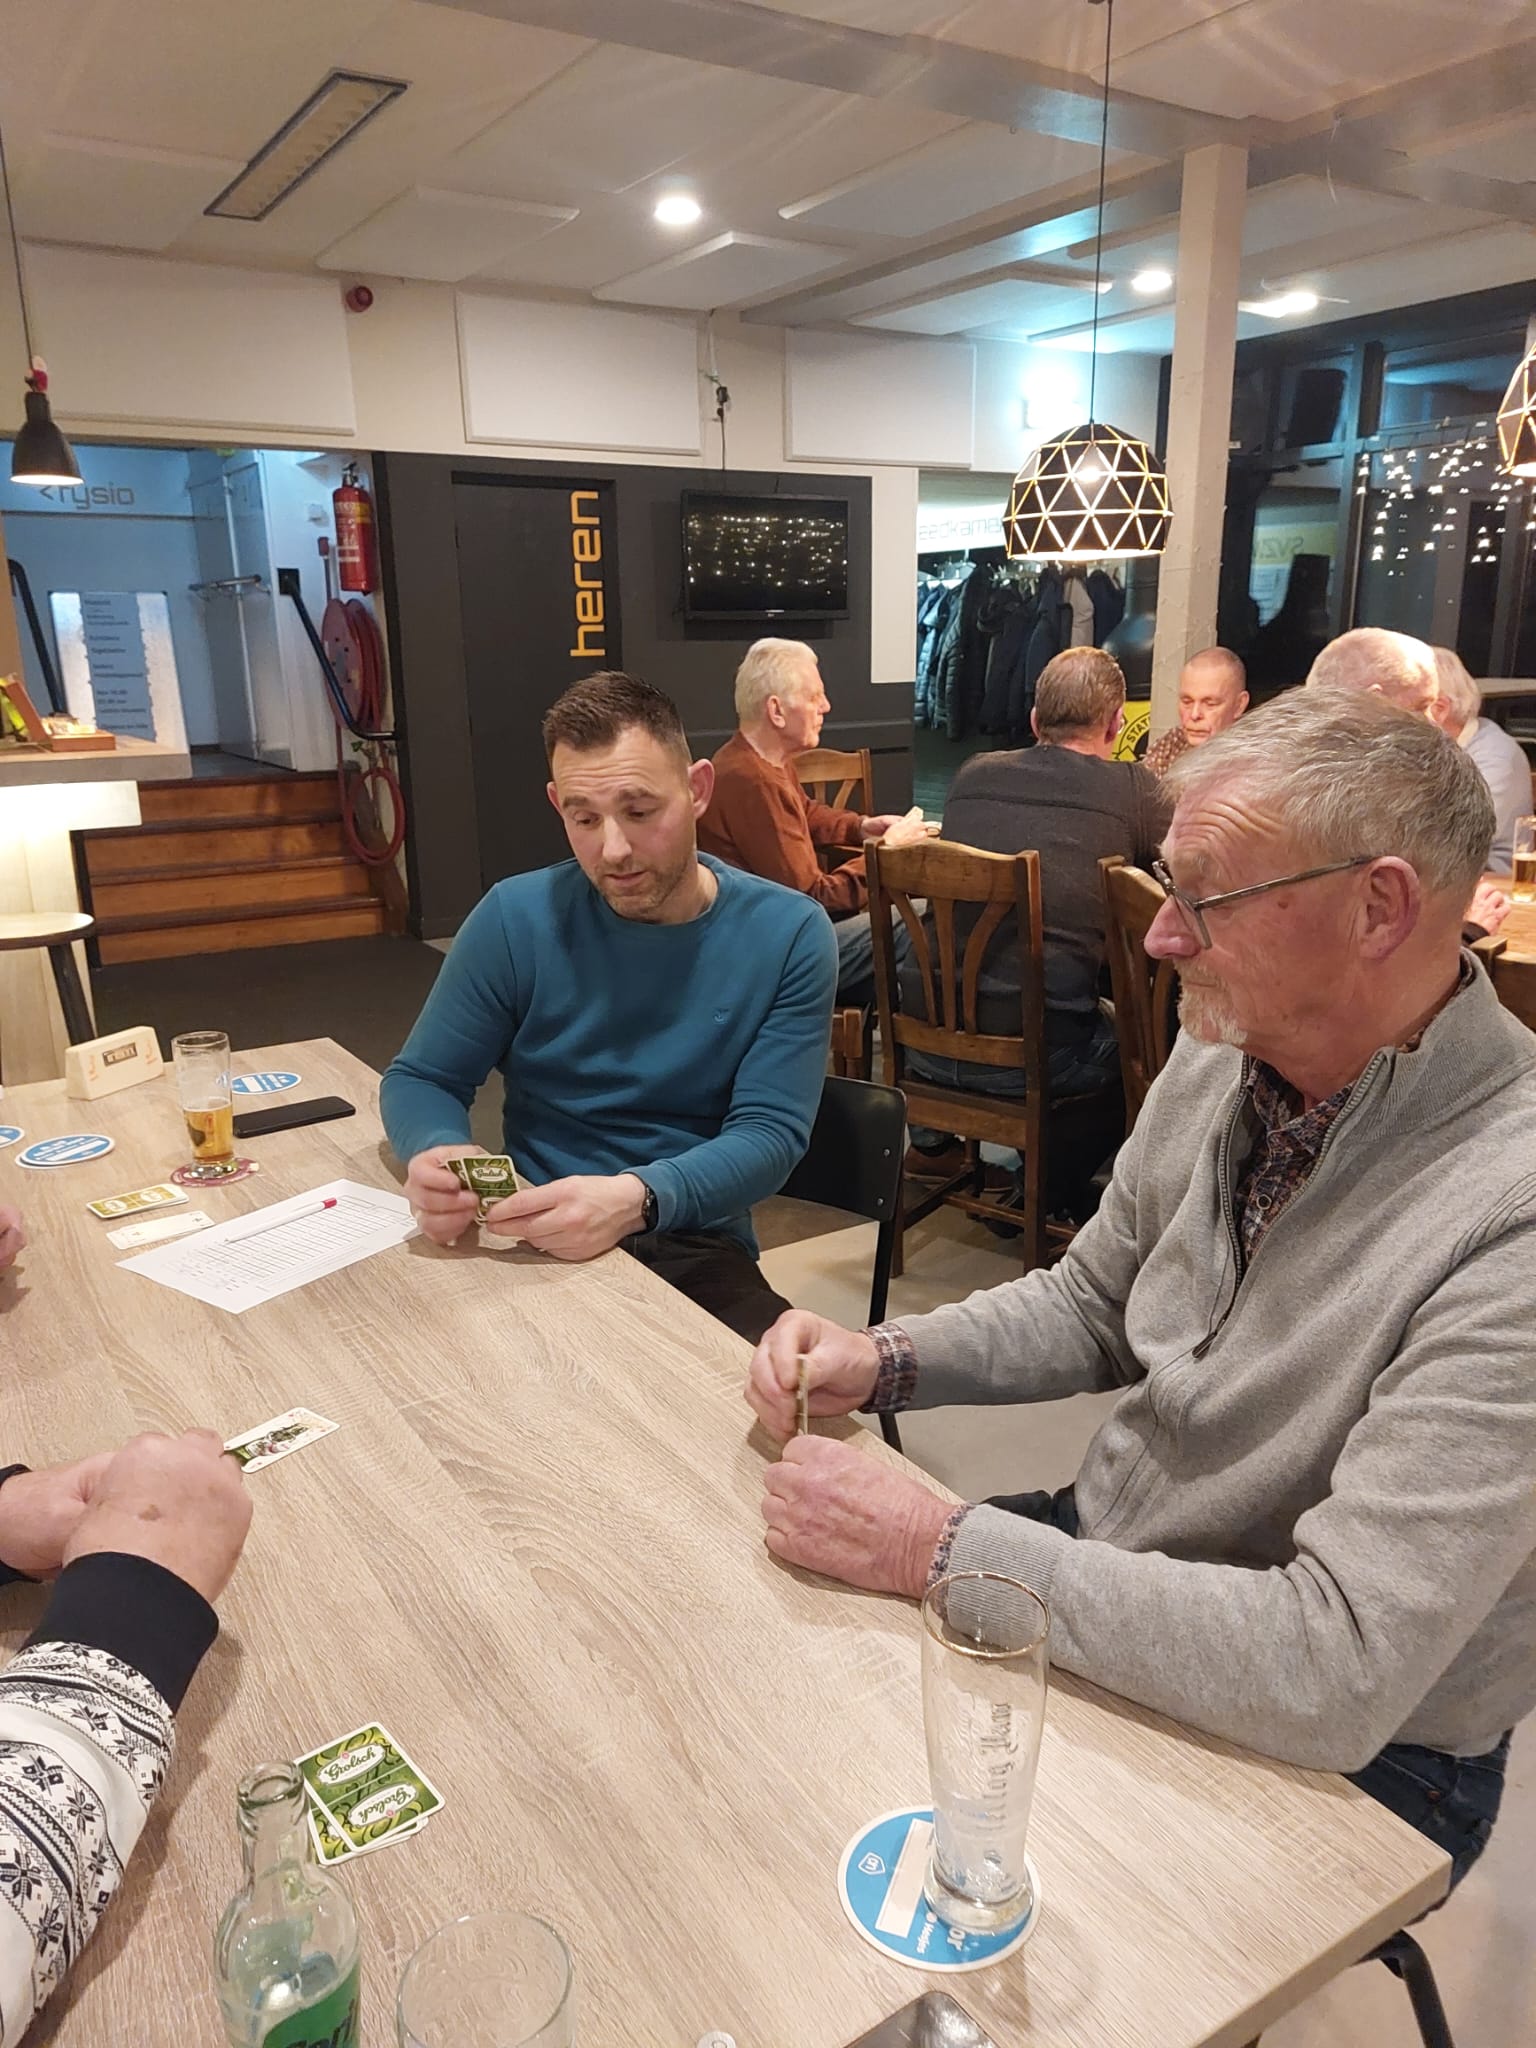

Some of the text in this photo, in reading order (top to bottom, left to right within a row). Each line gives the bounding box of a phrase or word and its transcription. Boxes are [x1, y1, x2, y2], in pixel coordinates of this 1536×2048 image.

[570, 490, 606, 657] heren
[325, 1747, 375, 1780] Grolsch
[358, 1788, 411, 1822] Grolsch
